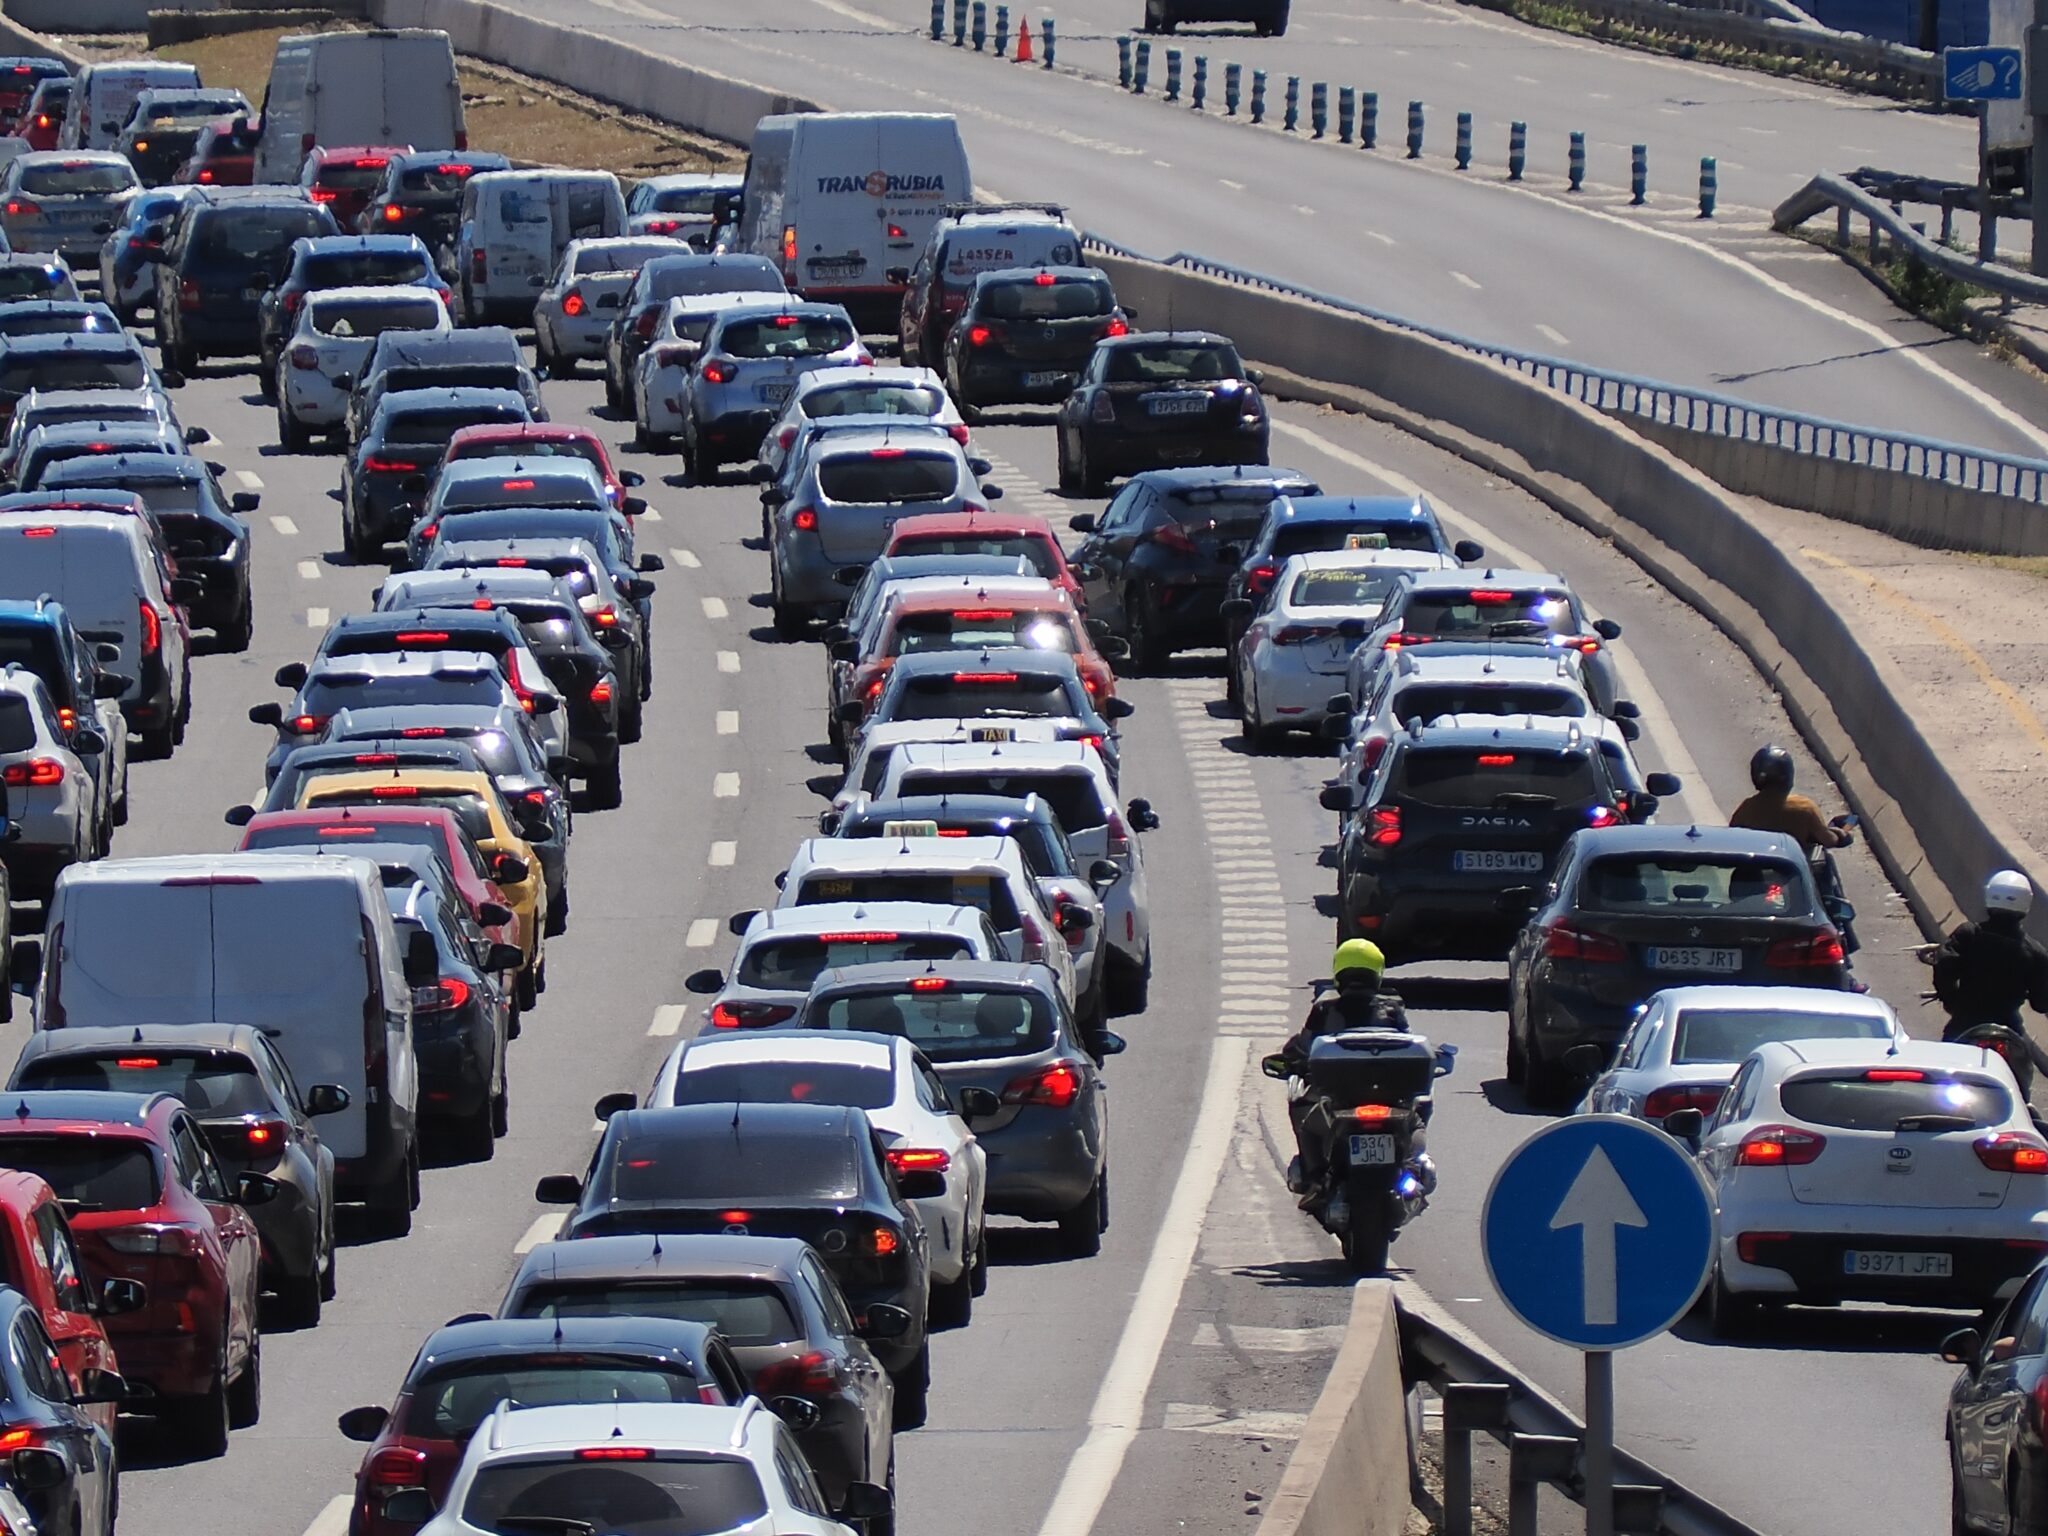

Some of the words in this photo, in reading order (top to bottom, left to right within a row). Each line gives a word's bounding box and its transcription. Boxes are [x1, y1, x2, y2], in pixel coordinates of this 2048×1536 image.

[982, 728, 1008, 741] TAXI
[1461, 816, 1531, 826] DACIA
[1659, 949, 1701, 966] 0635
[1706, 950, 1737, 968] JRT
[1361, 1149, 1385, 1163] JHJ
[1859, 1254, 1905, 1272] 9371
[1913, 1256, 1948, 1274] JFH
